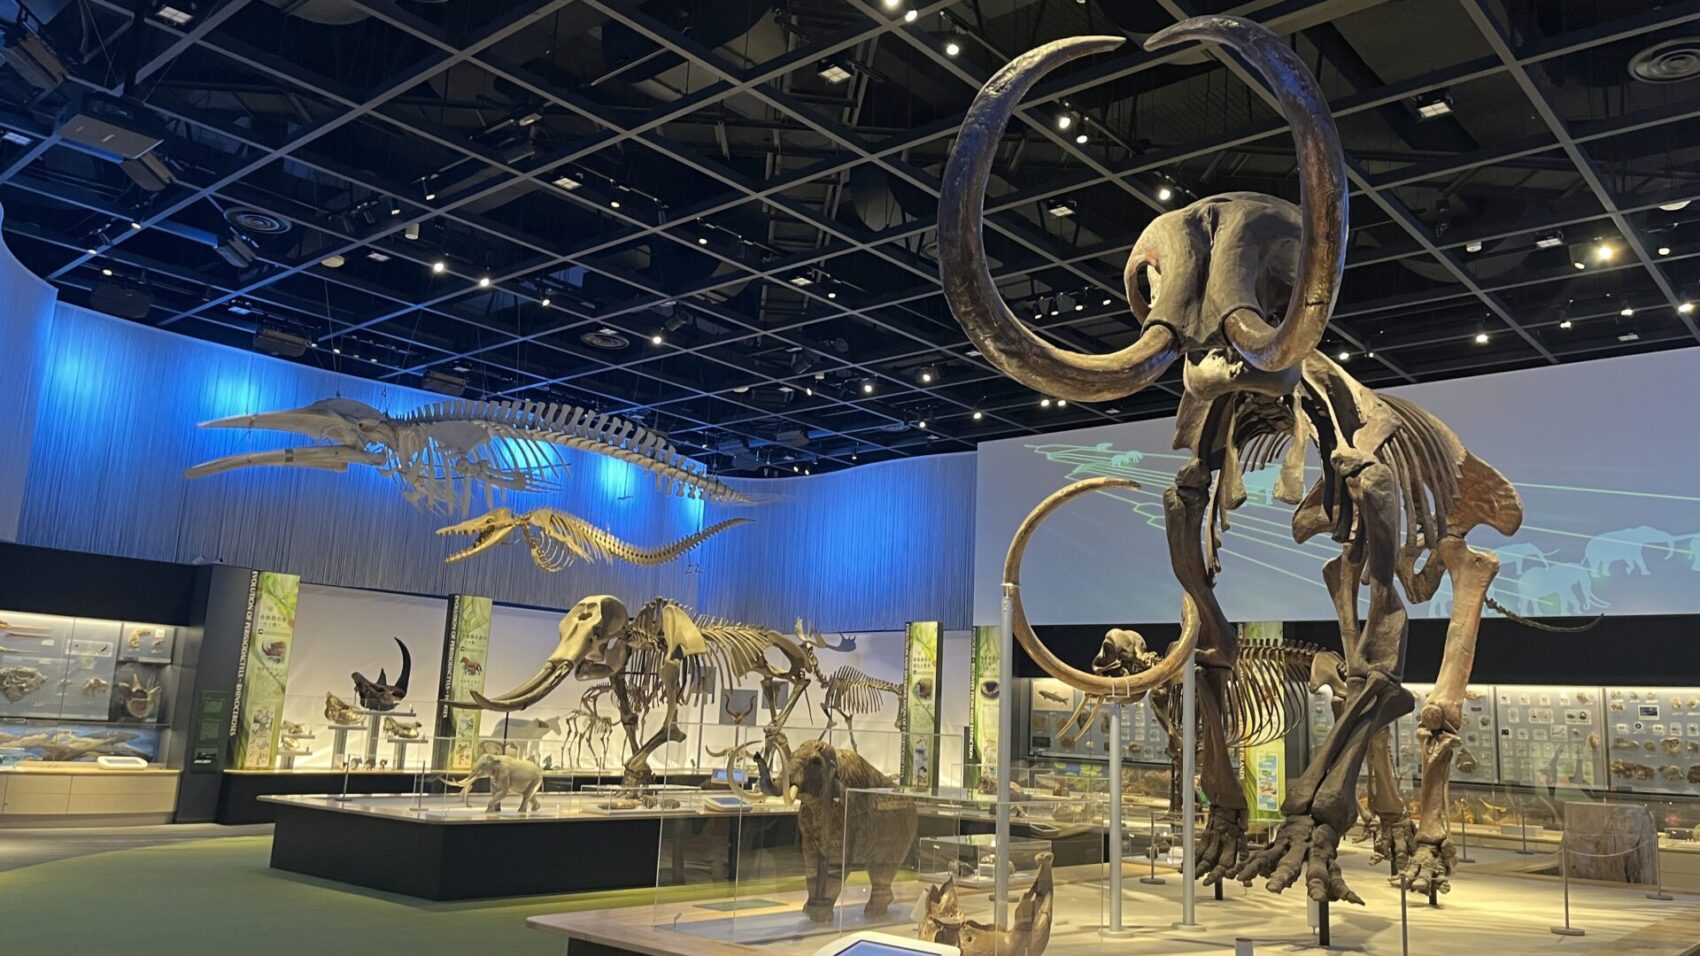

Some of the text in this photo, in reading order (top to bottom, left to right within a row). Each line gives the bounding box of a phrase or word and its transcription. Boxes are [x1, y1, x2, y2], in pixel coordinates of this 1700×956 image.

[246, 570, 258, 610] EVOLUTION
[245, 611, 253, 620] OF
[451, 595, 460, 629] EVOLUTION
[237, 621, 251, 677] PERISSODACTYLS
